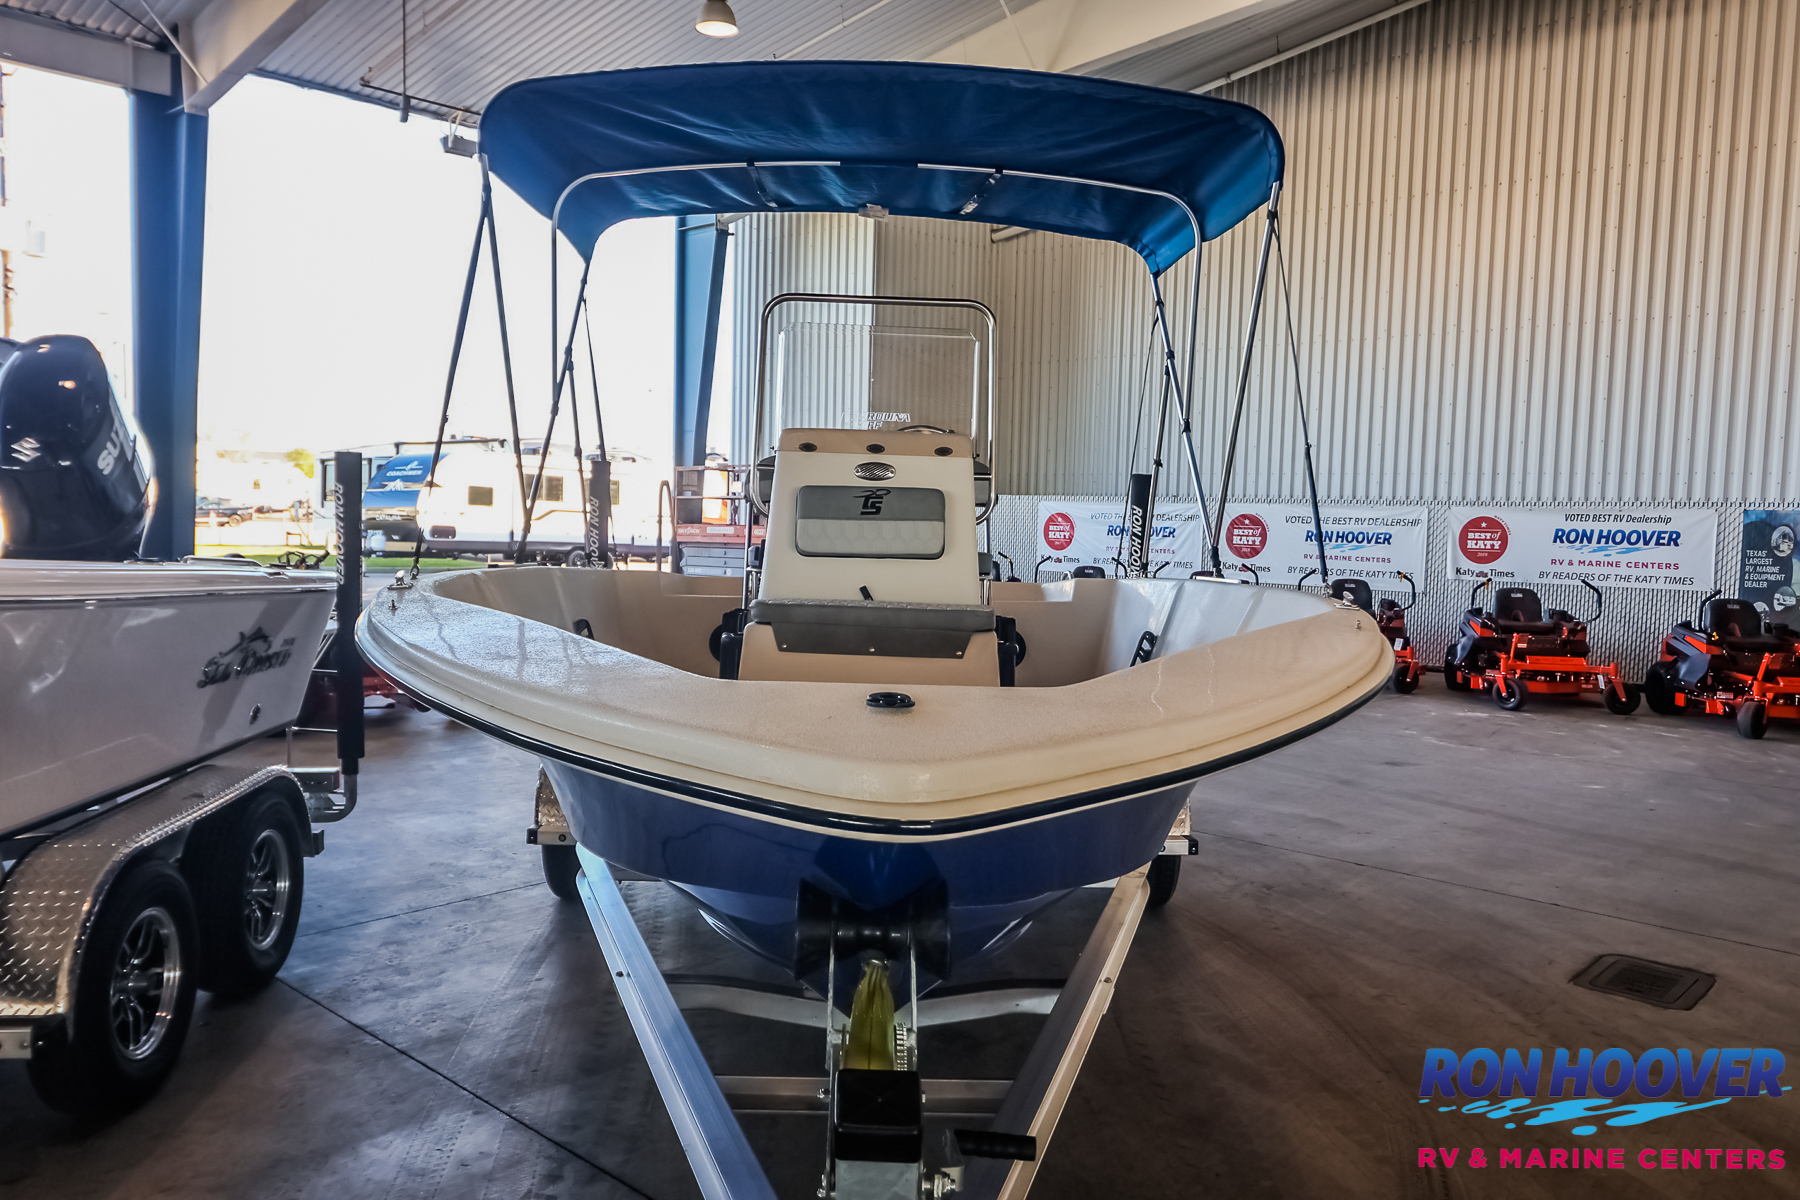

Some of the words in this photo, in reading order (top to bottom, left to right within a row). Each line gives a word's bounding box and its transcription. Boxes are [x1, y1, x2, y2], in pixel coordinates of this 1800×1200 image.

[590, 497, 600, 527] RON
[1090, 512, 1113, 520] VOTED
[1131, 504, 1143, 536] RON
[1156, 513, 1200, 522] DEALERSHIP
[1285, 516, 1313, 524] VOTED
[1332, 517, 1351, 525] BEST
[1367, 518, 1422, 527] DEALERSHIP
[1564, 514, 1590, 522] VOTED
[1592, 514, 1612, 522] BEST
[1613, 515, 1624, 523] RV
[1625, 515, 1672, 525] Dealership
[1049, 531, 1070, 539] KATY
[1253, 528, 1262, 537] of
[1491, 531, 1501, 540] of
[1233, 536, 1262, 545] KATY
[1335, 531, 1393, 545] HOOVER
[1552, 528, 1595, 544] RON
[1596, 529, 1682, 547] HOOVER
[1467, 540, 1501, 549] KATY
[1355, 556, 1392, 564] CENTERS
[1222, 562, 1239, 572] Katy
[1578, 560, 1621, 568] MARINE
[1626, 562, 1680, 570] CENTERS
[1745, 565, 1755, 573] RV,
[1287, 566, 1298, 574] BY
[1349, 569, 1364, 577] THE
[1365, 570, 1387, 578] KATY
[1456, 567, 1475, 577] Katy
[1489, 569, 1515, 578] Times
[1538, 571, 1551, 579] BY
[1552, 572, 1595, 581] READERS
[1597, 573, 1611, 582] OF
[1613, 574, 1632, 583] THE
[1634, 575, 1661, 584] KATY
[1663, 576, 1695, 585] TIMES
[1750, 573, 1785, 581] EQUIPMENT
[1744, 580, 1768, 588] DEALER
